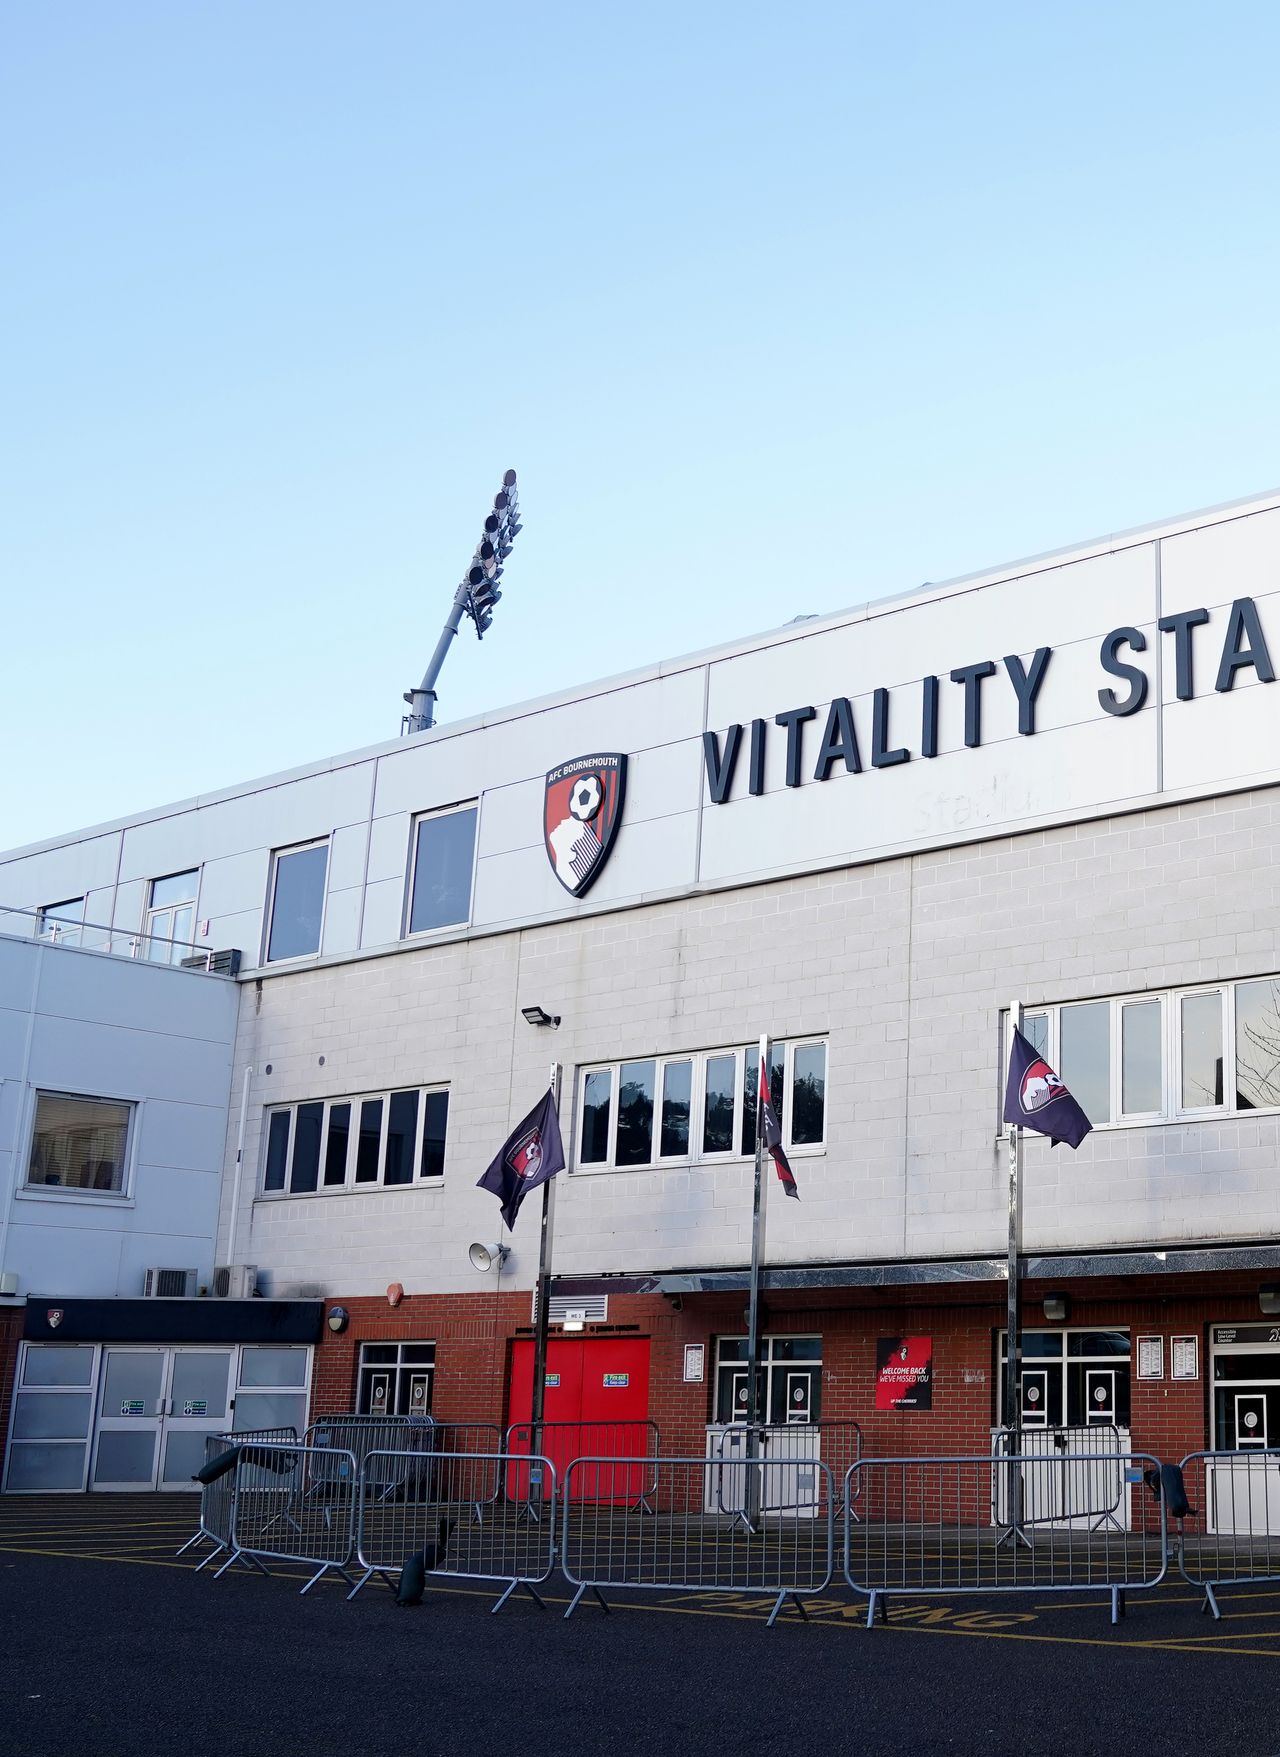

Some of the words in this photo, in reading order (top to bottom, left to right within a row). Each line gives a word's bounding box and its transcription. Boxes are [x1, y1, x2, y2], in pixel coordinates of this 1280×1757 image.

[702, 646, 1052, 805] VITALITY
[548, 768, 563, 783] AFC
[563, 757, 618, 775] BOURNEMOUTH
[882, 1367, 909, 1375] WELCOME
